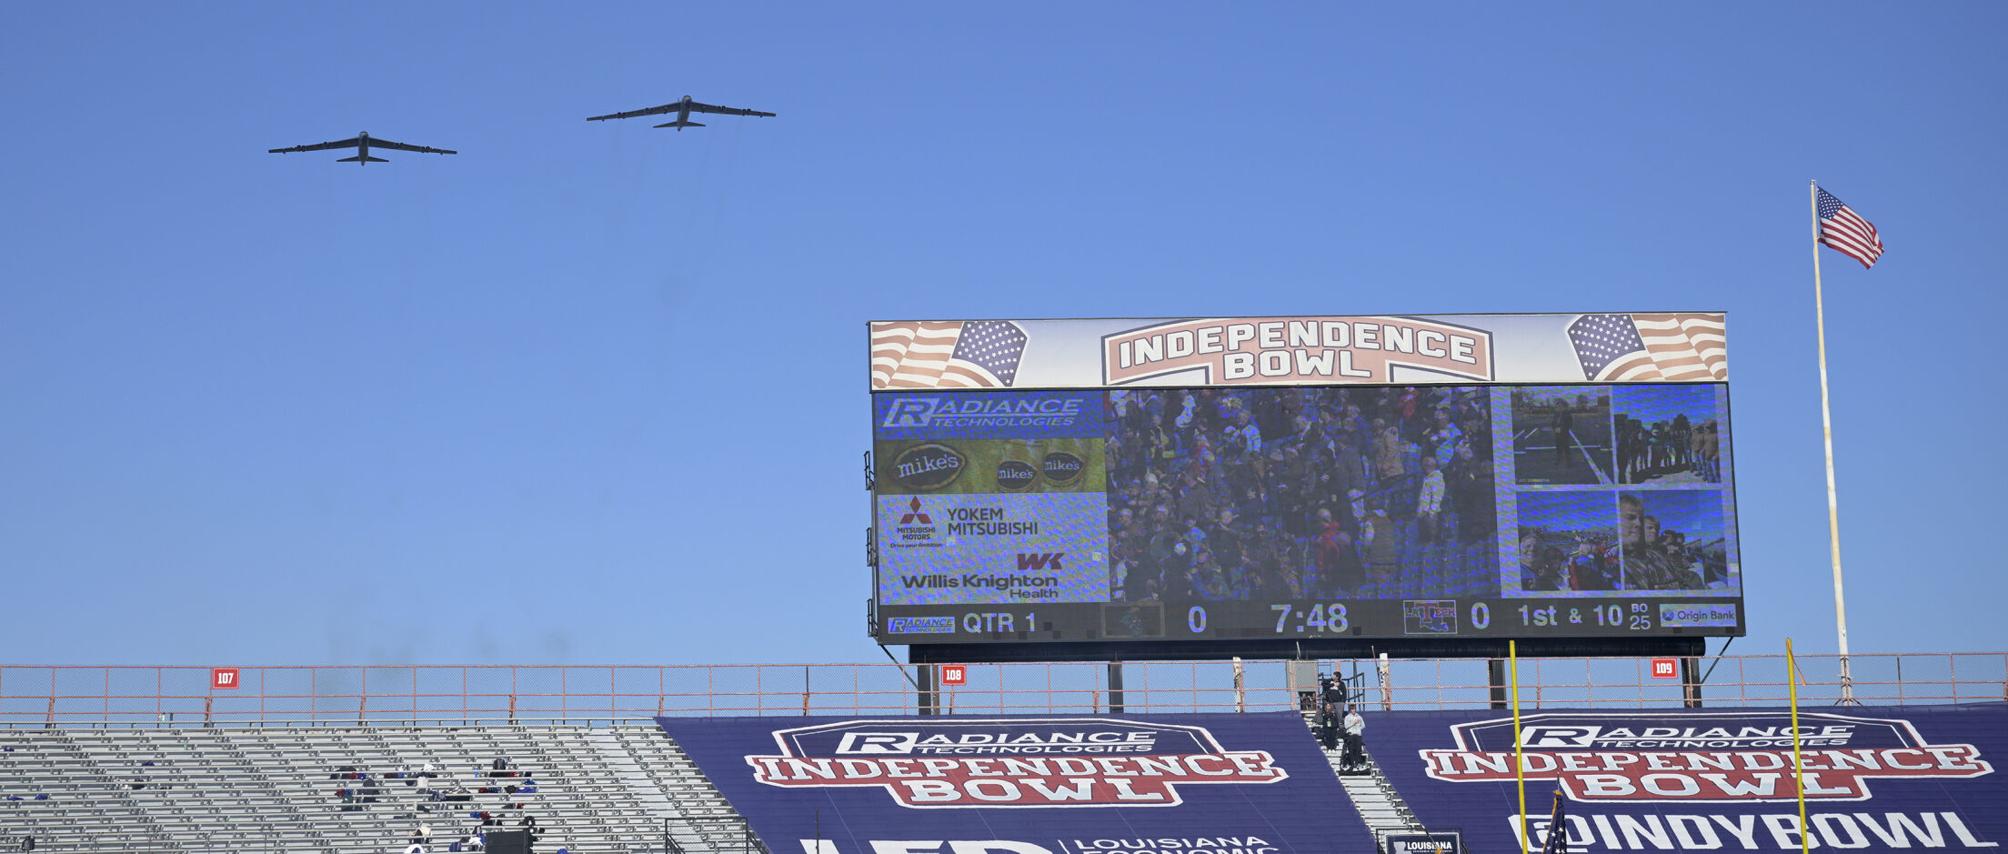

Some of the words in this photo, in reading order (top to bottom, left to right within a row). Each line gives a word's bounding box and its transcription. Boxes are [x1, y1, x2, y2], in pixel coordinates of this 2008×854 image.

[1117, 320, 1478, 369] INDEPENDENCE
[1223, 349, 1372, 380] BOWL
[883, 398, 1084, 427] RADIANCE
[934, 416, 1075, 427] TECHNOLOGIES
[897, 454, 960, 478] mike's
[947, 508, 1003, 521] YOKEM
[948, 522, 1038, 535] MITSUBISHI
[902, 574, 958, 588] Willis
[963, 573, 1058, 590] Knighton
[1010, 588, 1058, 598] Health
[1271, 603, 1349, 633] 7:48
[1471, 602, 1490, 629] 0
[1518, 604, 1557, 626] 1st
[1569, 608, 1582, 623] &
[1593, 604, 1624, 626] 10
[1631, 603, 1648, 612] BO
[1677, 610, 1706, 621] Origin
[1711, 610, 1735, 619] Bank
[963, 612, 1014, 633] QTR
[1026, 612, 1035, 632] 1
[1188, 605, 1207, 633] 0
[1629, 615, 1651, 630] 25
[217, 672, 234, 684] 107
[945, 670, 962, 681] 108
[1656, 662, 1672, 674] 109
[836, 731, 1157, 754] RADIANCE
[1513, 725, 1855, 748] RADIANCE
[917, 745, 1153, 755] TECHNOLOGIES
[1432, 747, 1979, 775] INDEPENDENCE
[758, 753, 1276, 781] INDEPENDENCE
[901, 778, 1164, 802] BOWL
[1574, 773, 1853, 796] BOWL
[1074, 836, 1270, 849] LOUISIANA
[1508, 812, 2000, 853] @INDYBOWL
